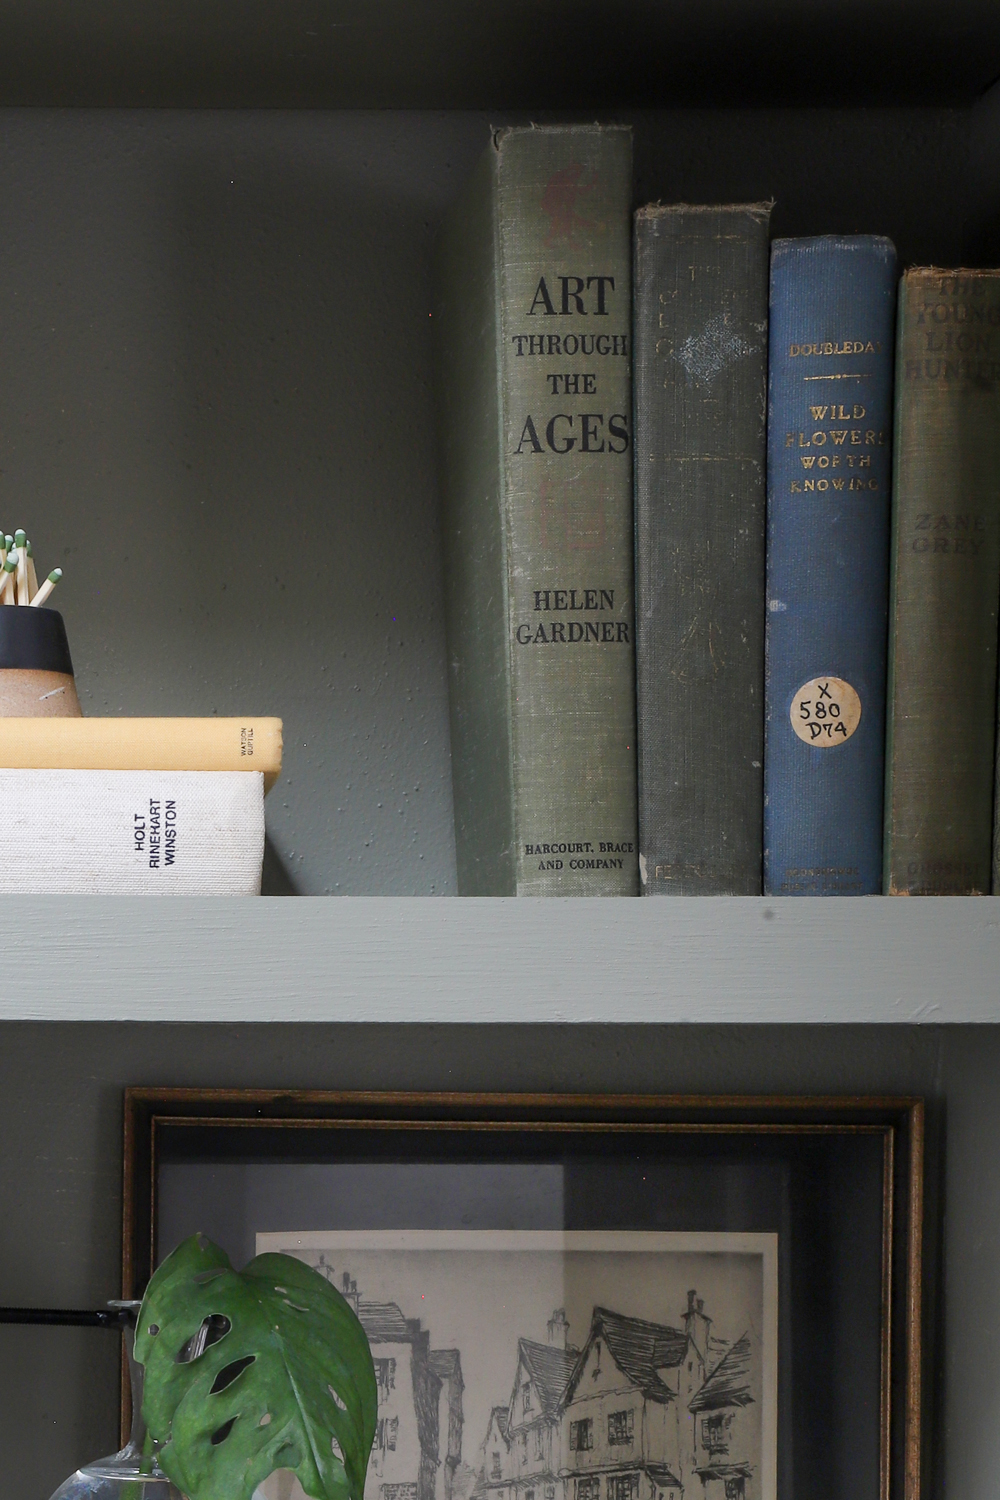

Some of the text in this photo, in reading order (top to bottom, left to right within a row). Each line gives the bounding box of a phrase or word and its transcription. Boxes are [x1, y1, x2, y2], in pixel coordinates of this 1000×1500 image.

[526, 276, 616, 317] ART
[512, 333, 629, 358] THROUGH
[546, 374, 597, 396] THE
[809, 404, 867, 421] WILD
[513, 413, 630, 455] AGES
[800, 455, 872, 470] WORTH
[789, 478, 880, 494] KNOWING
[914, 514, 987, 531] ZANE
[532, 589, 616, 613] HELEN
[515, 620, 631, 646] GARDNER
[817, 682, 832, 700] X
[799, 700, 841, 720] 580
[805, 721, 848, 740] D74
[134, 813, 147, 852] HOLT
[149, 798, 161, 869] RINEHART
[164, 800, 177, 866] WINSTON
[598, 842, 634, 853] BRACE
[538, 858, 624, 871] AND COMPANY
